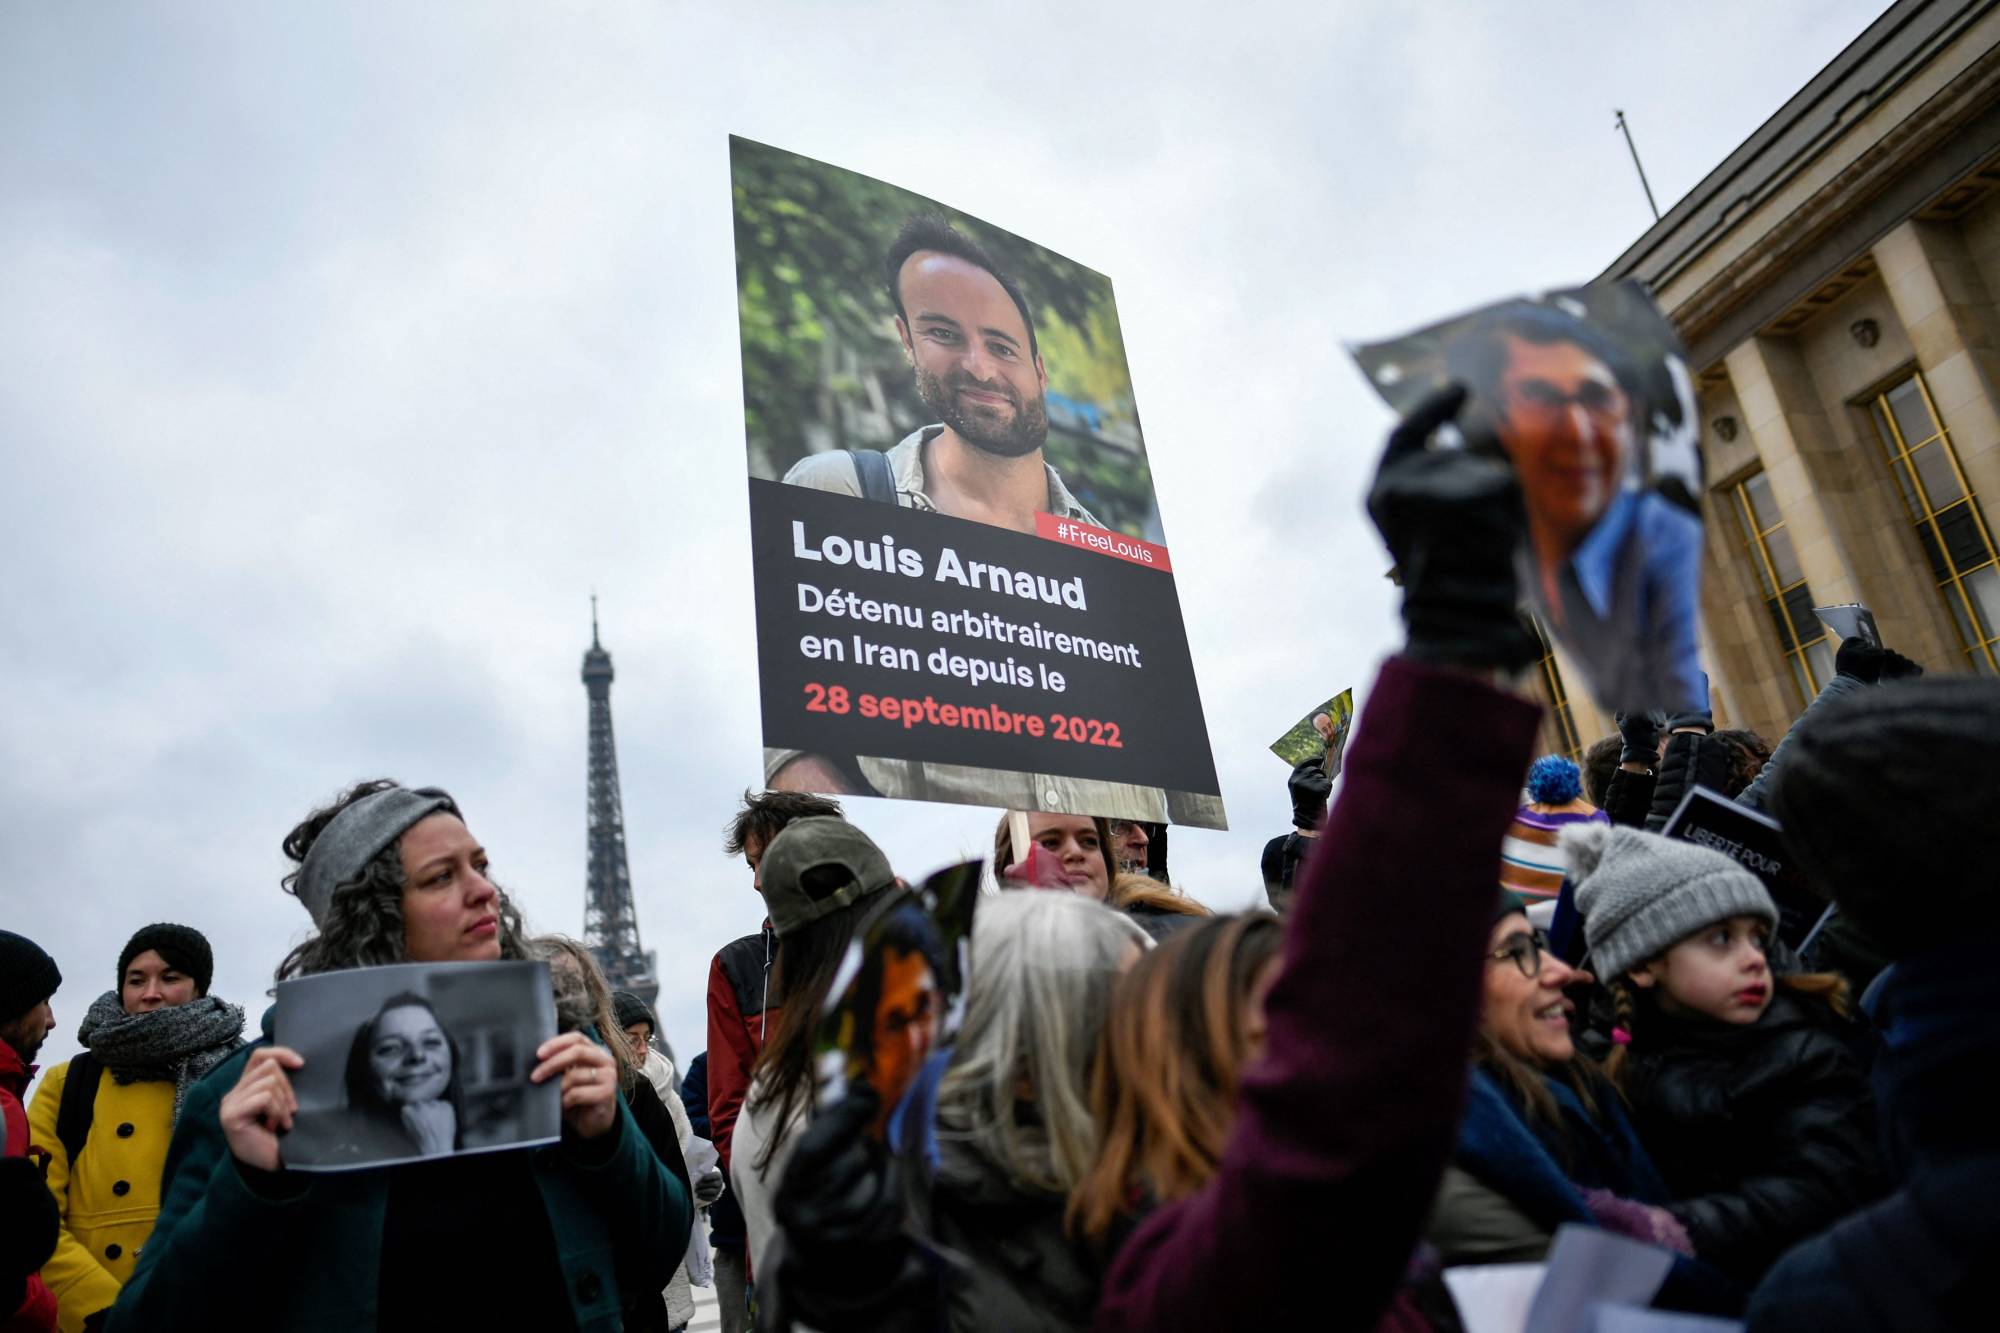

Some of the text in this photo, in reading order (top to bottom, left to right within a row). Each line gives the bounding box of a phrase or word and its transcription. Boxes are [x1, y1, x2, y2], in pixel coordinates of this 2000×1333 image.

[793, 520, 1087, 610] Louis Arnaud
[1058, 523, 1153, 562] #FreeLouis
[798, 583, 1141, 668] Détenu arbitrairement
[799, 635, 1066, 692] en Iran depuis le
[804, 683, 1123, 748] 28 septembre 2022
[1684, 823, 1782, 876] LIBERTÉ POUR
